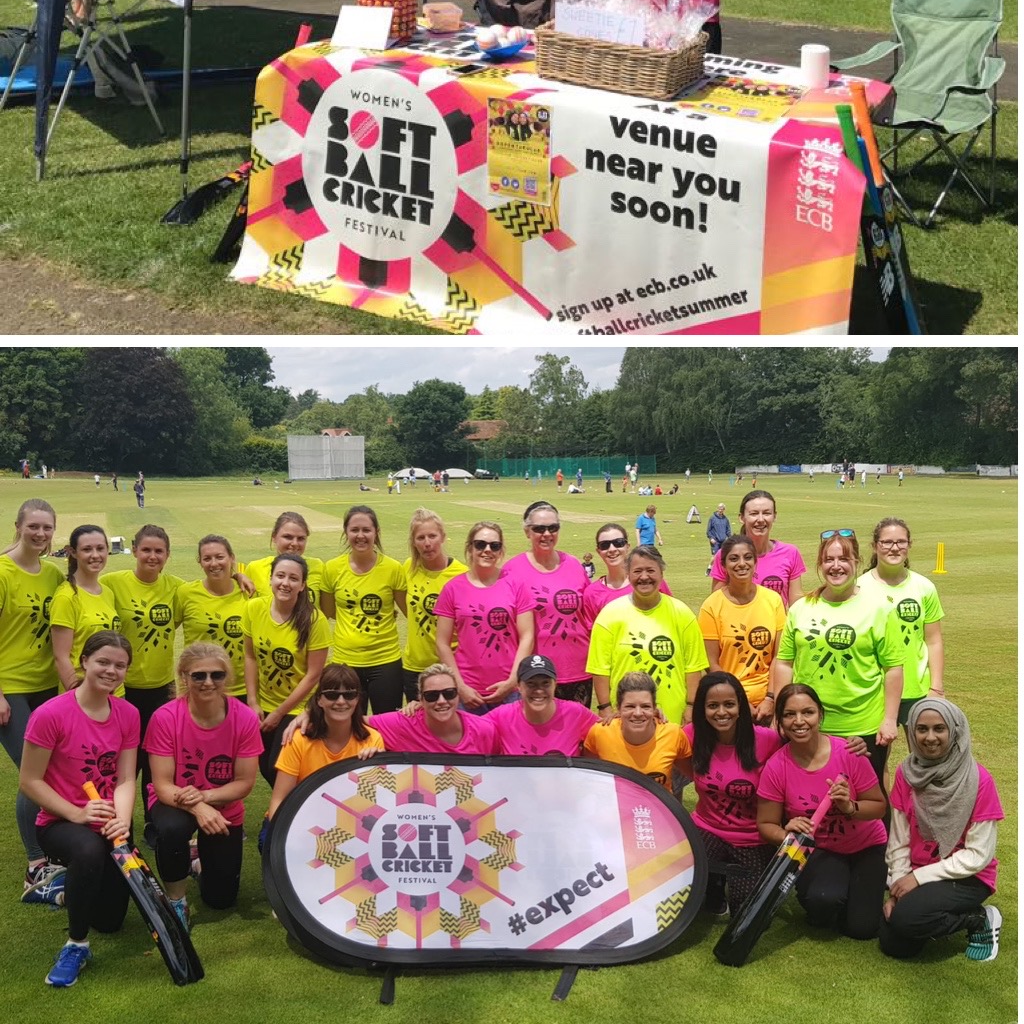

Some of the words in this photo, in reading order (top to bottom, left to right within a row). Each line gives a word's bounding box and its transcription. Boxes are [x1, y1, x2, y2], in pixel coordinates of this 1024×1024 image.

[704, 55, 784, 74] ming
[350, 89, 413, 112] WOMEN'S
[327, 105, 438, 161] SOFT
[609, 114, 718, 158] venue
[325, 139, 435, 200] BALL
[585, 147, 664, 185] near
[671, 166, 741, 203] you
[322, 176, 434, 226] CRICKET
[610, 190, 709, 234] soon!
[796, 205, 833, 232] ECB
[344, 217, 407, 242] FESTIVAL
[556, 302, 590, 322] sign
[591, 296, 614, 313] up
[615, 288, 635, 305] at
[636, 262, 718, 298] ecb.co.uk
[381, 823, 452, 842] SOFT
[636, 841, 656, 849] ECB
[381, 841, 453, 860] BALL
[381, 859, 453, 873] CRICKET
[507, 861, 616, 937] #expect
